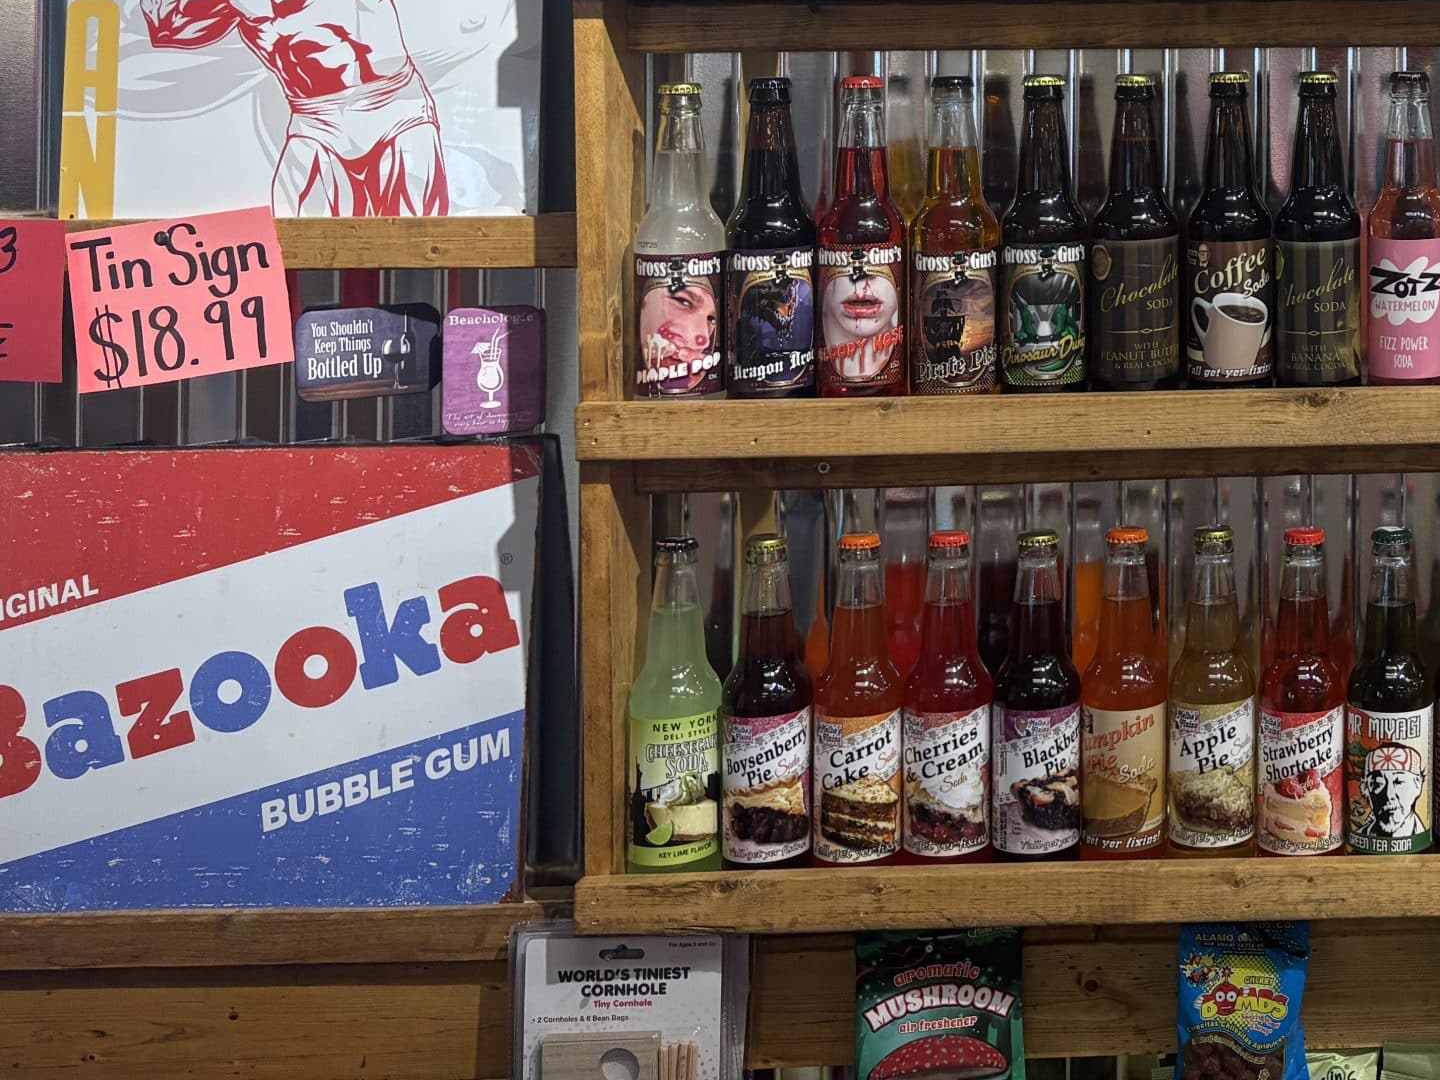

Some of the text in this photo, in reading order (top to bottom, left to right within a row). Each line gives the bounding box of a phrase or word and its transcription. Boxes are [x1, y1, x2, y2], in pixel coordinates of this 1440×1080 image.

[70, 223, 269, 296] Tin Sign
[1004, 245, 1085, 264] Gross Gus's
[1194, 248, 1266, 294] Coffee
[1375, 301, 1435, 312] WATERMELON
[311, 319, 373, 337] You Shouldn't
[89, 296, 266, 388] $18.99
[315, 338, 371, 355] Keep Things
[1002, 334, 1085, 366] Dinosaur Dung
[1380, 337, 1428, 350] FIZZ POWER
[307, 353, 382, 379] Bottled Up
[1393, 354, 1413, 368] SODA
[0, 575, 520, 798] Bazooka
[652, 715, 717, 733] NEW YORK
[688, 727, 710, 738] STYLE
[1368, 715, 1421, 740] MIYAGI
[727, 726, 807, 775] Boysenberry
[830, 729, 892, 767] Carrot
[905, 726, 978, 765] Cherries
[1180, 724, 1237, 759] Apple
[1263, 724, 1334, 762] Strawberry
[666, 753, 708, 778] SODA
[922, 740, 983, 779] Cream
[1198, 754, 1229, 774] Pie
[1266, 747, 1332, 781] Shortcake
[261, 729, 510, 832] BUBBLE GUM
[747, 768, 772, 787] Pie
[822, 765, 869, 791] Cake
[674, 849, 689, 857] LIME
[690, 843, 712, 855] FLAVOR
[1371, 839, 1411, 852] TEA SODA
[558, 967, 690, 983] WORLD'S TINIEST
[894, 961, 980, 988] aromatic
[581, 982, 667, 997] CORNHOLE
[593, 999, 652, 1008] Tiny Cornhole
[863, 985, 1015, 1033] MUSHROOM
[899, 1016, 978, 1034] air freshener
